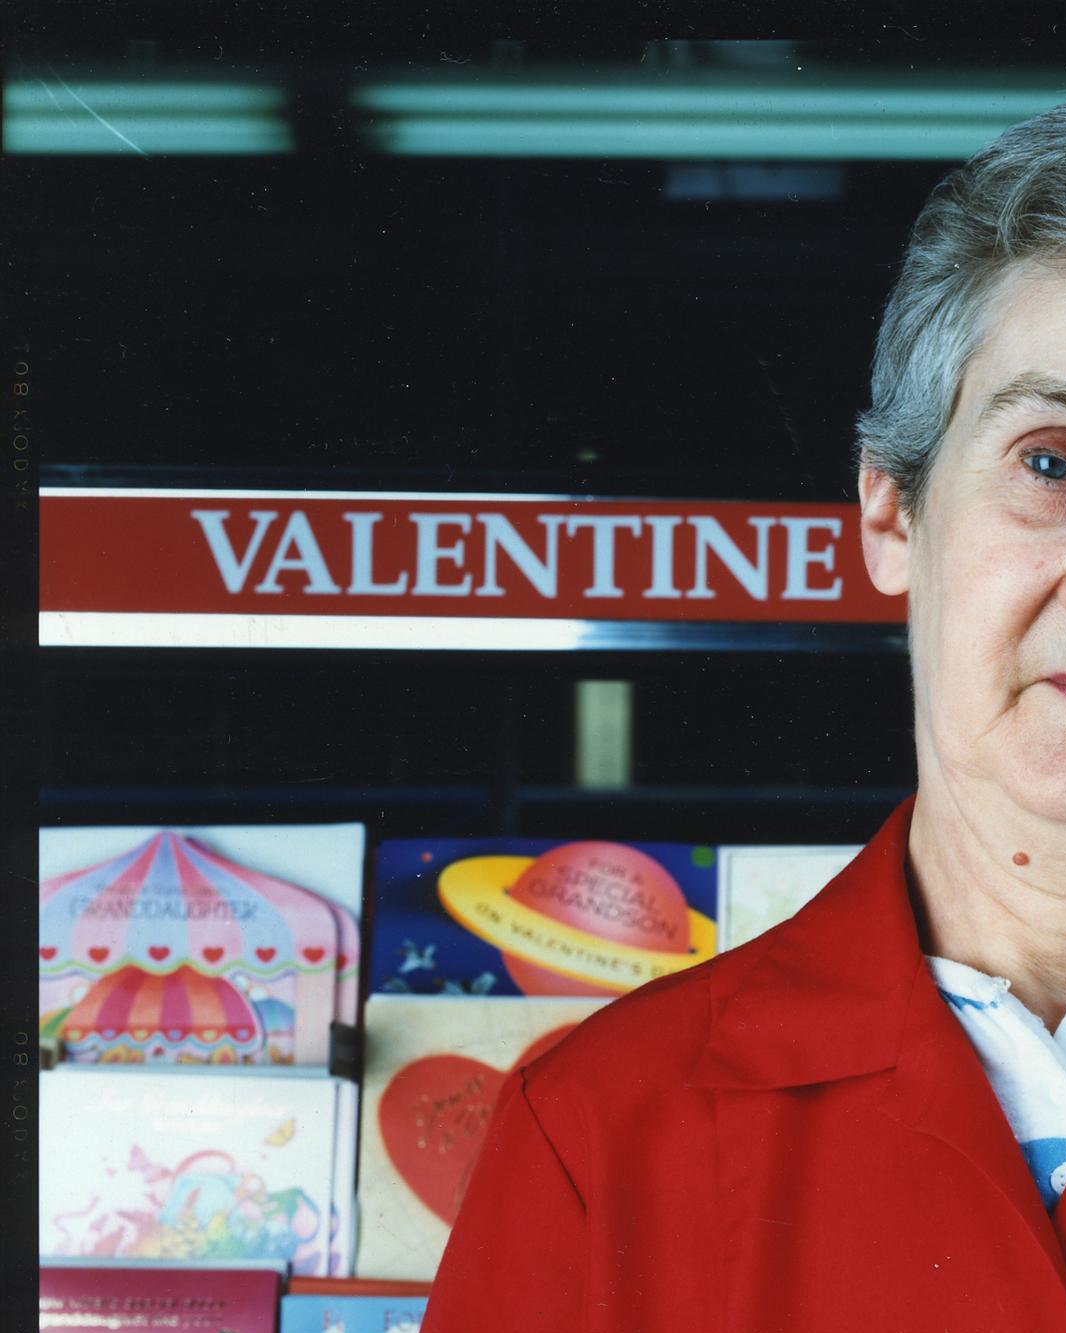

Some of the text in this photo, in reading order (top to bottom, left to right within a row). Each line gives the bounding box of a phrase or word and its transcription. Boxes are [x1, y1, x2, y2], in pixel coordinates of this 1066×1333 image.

[191, 509, 843, 602] VALENTINE
[527, 877, 679, 941] GRANDSON
[557, 863, 661, 914] SPECIAL
[474, 901, 505, 925] ON
[510, 919, 642, 978] VALENTINE'S
